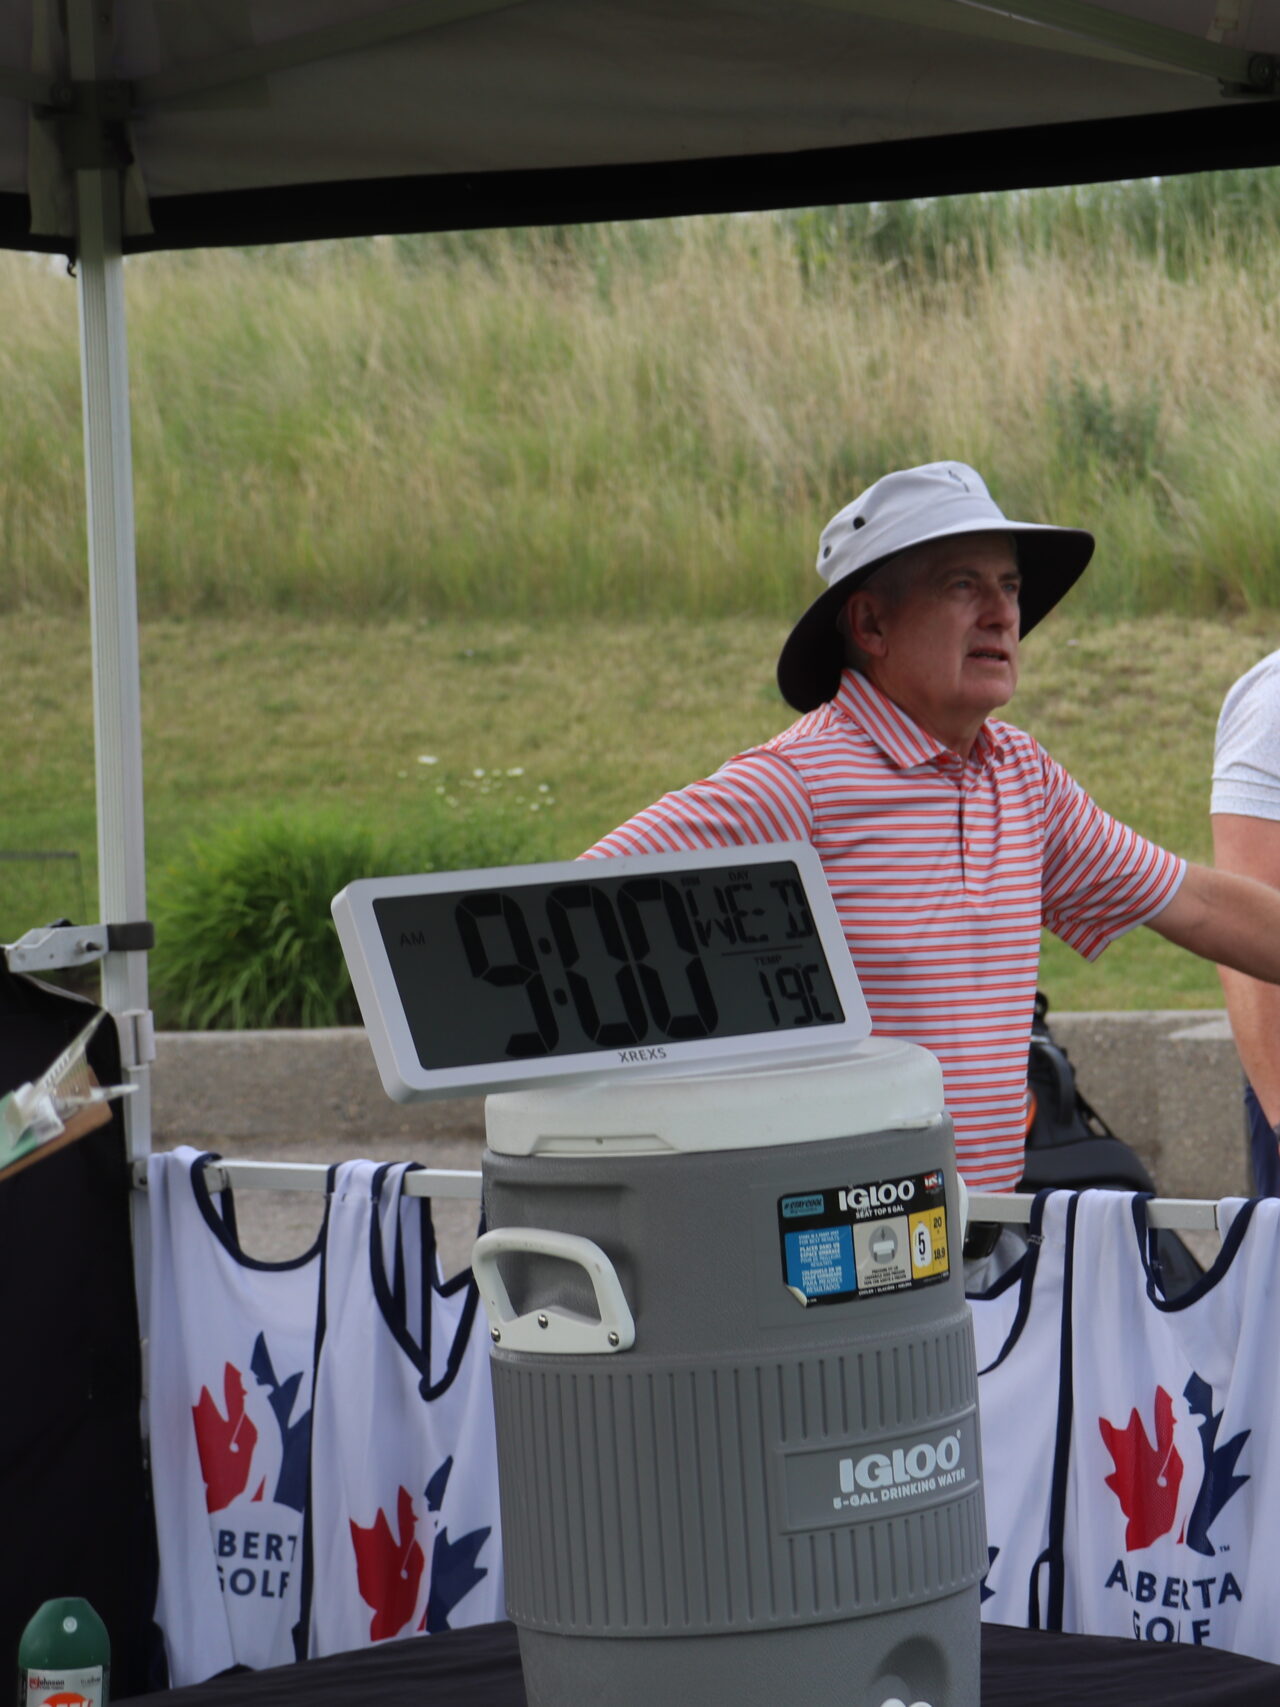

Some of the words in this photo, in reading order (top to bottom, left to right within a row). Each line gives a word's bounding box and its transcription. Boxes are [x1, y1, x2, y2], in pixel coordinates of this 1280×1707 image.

[728, 871, 750, 881] DAY
[399, 931, 426, 948] AM
[455, 878, 719, 1057] 9:00
[684, 877, 815, 948] WED
[754, 954, 782, 966] TEMP
[617, 1047, 668, 1064] XREXS
[838, 1179, 915, 1212] IGLOO
[874, 1206, 887, 1217] TOP
[892, 1203, 904, 1213] GAL
[933, 1216, 942, 1228] 20
[918, 1231, 926, 1256] 5
[839, 1435, 961, 1493] IGLOO
[833, 1491, 878, 1510] 5-GAL
[881, 1479, 937, 1501] DRINKING
[937, 1467, 966, 1488] WATER
[217, 1529, 298, 1562] BERT
